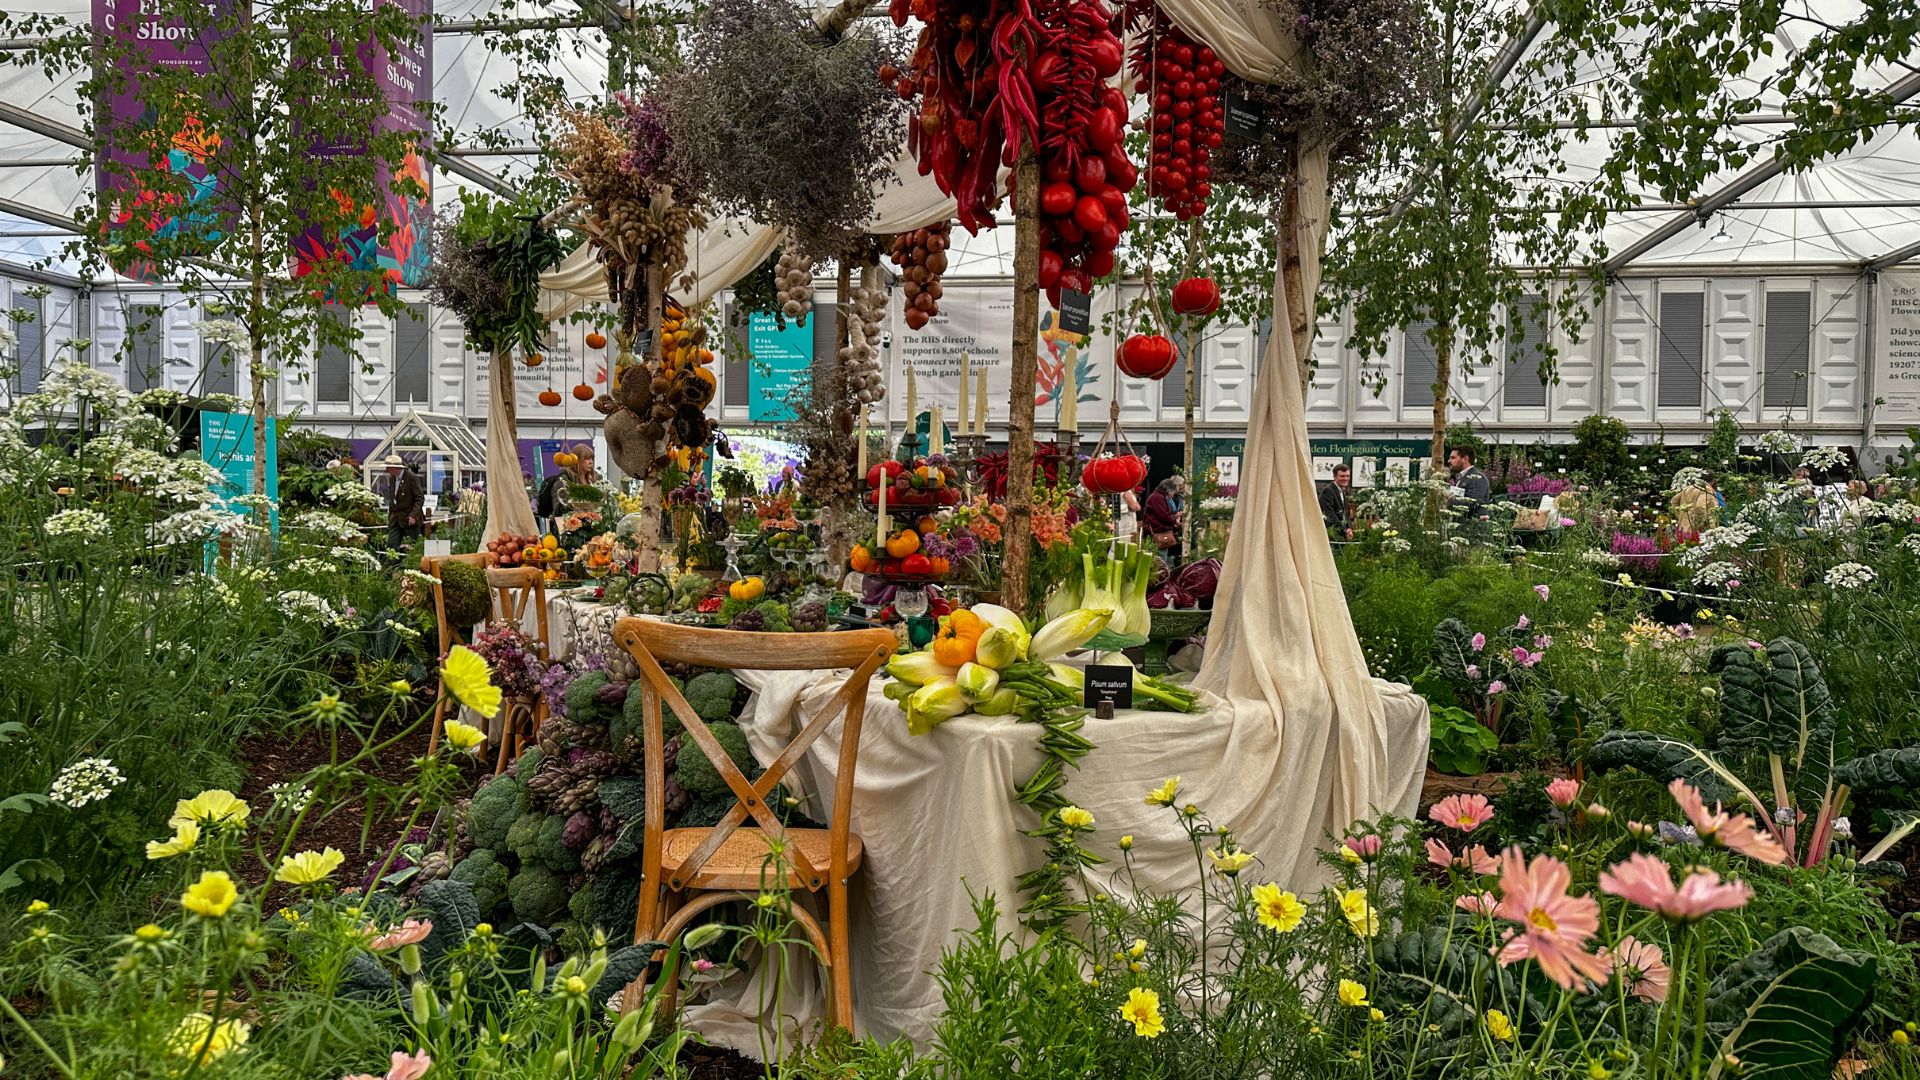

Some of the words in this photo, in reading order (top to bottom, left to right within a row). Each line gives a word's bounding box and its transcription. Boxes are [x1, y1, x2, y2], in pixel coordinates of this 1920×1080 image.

[387, 64, 414, 94] Show
[942, 336, 976, 345] directly
[902, 348, 940, 356] supports
[1330, 444, 1380, 454] Florilegium
[1383, 445, 1414, 455] Society
[1091, 680, 1107, 688] Pisum
[1108, 680, 1127, 688] sativum
